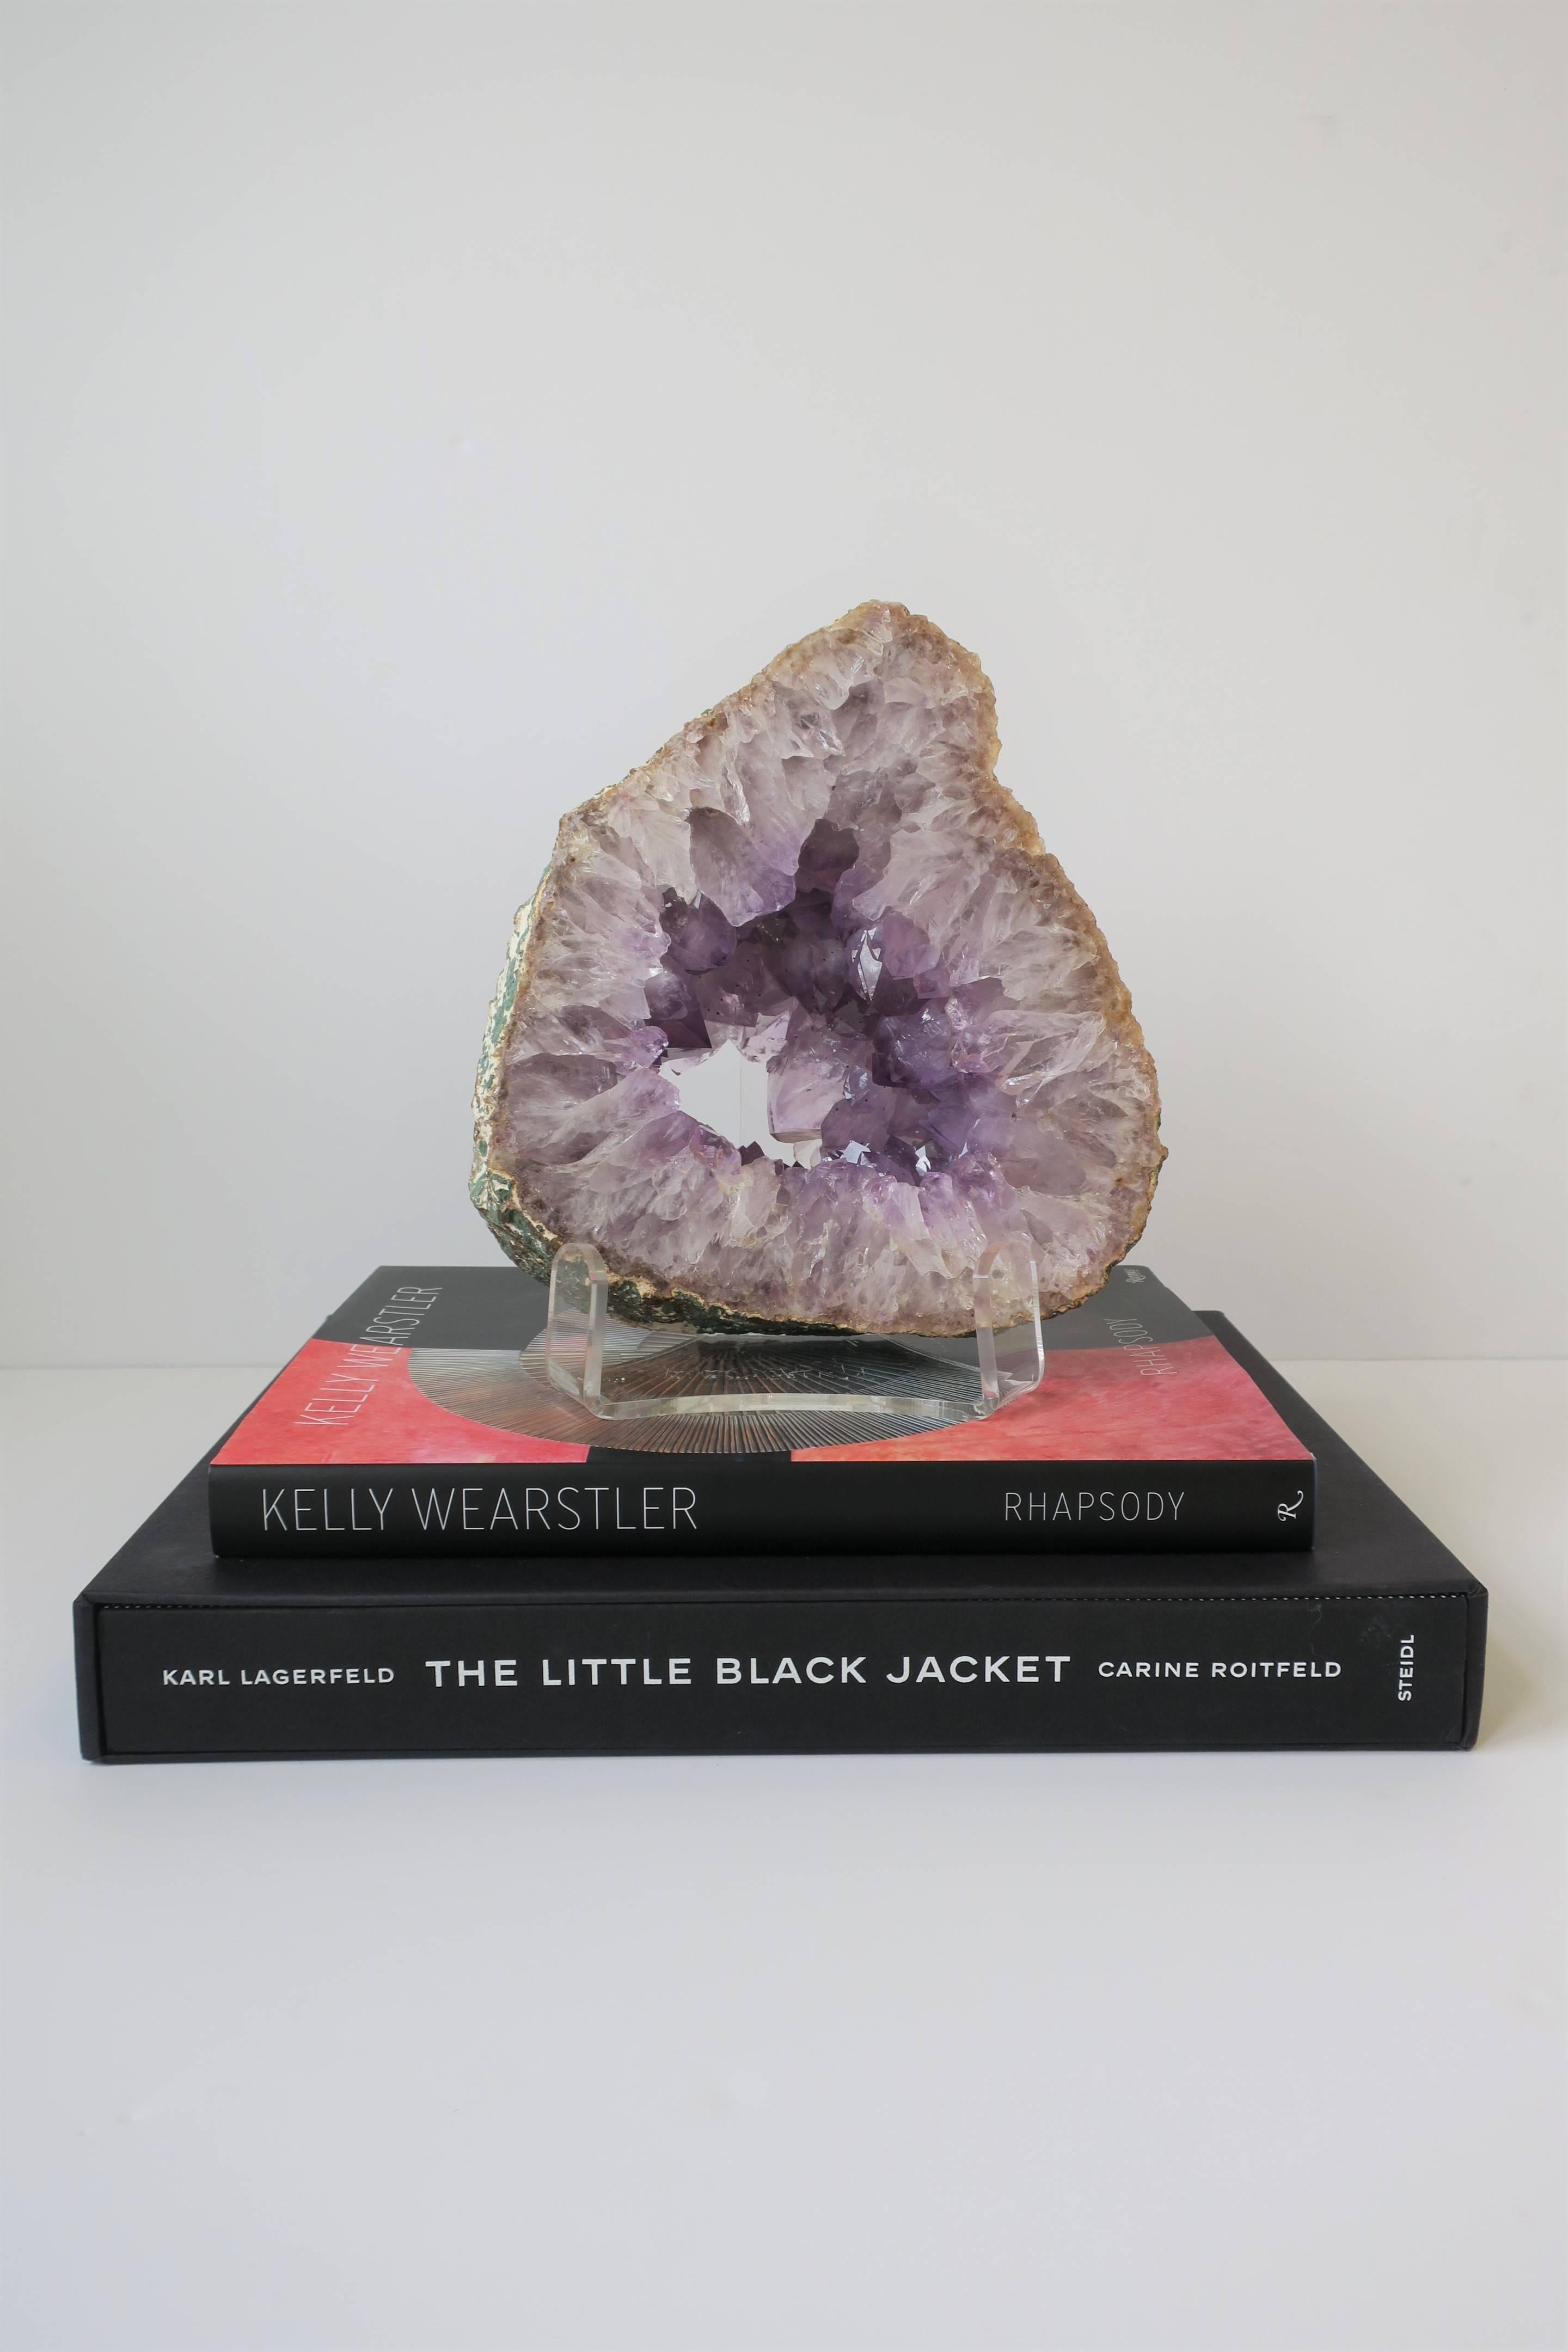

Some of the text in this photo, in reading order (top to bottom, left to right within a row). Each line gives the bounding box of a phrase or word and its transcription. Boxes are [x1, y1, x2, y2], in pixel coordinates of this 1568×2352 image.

[293, 1286, 443, 1425] KELLY WEARSTLER
[1102, 1318, 1178, 1376] RHAPSODY
[262, 1487, 697, 1531] KELLY WEARSTLER
[1005, 1491, 1185, 1521] RHAPSODY
[1277, 1490, 1304, 1522] R
[163, 1668, 395, 1686] KARL LAGERFELD
[425, 1655, 1071, 1687] THE LITTLE BLACK JACKET
[1098, 1661, 1342, 1679] CARINE ROITFELD
[1397, 1634, 1415, 1701] STEIDL
